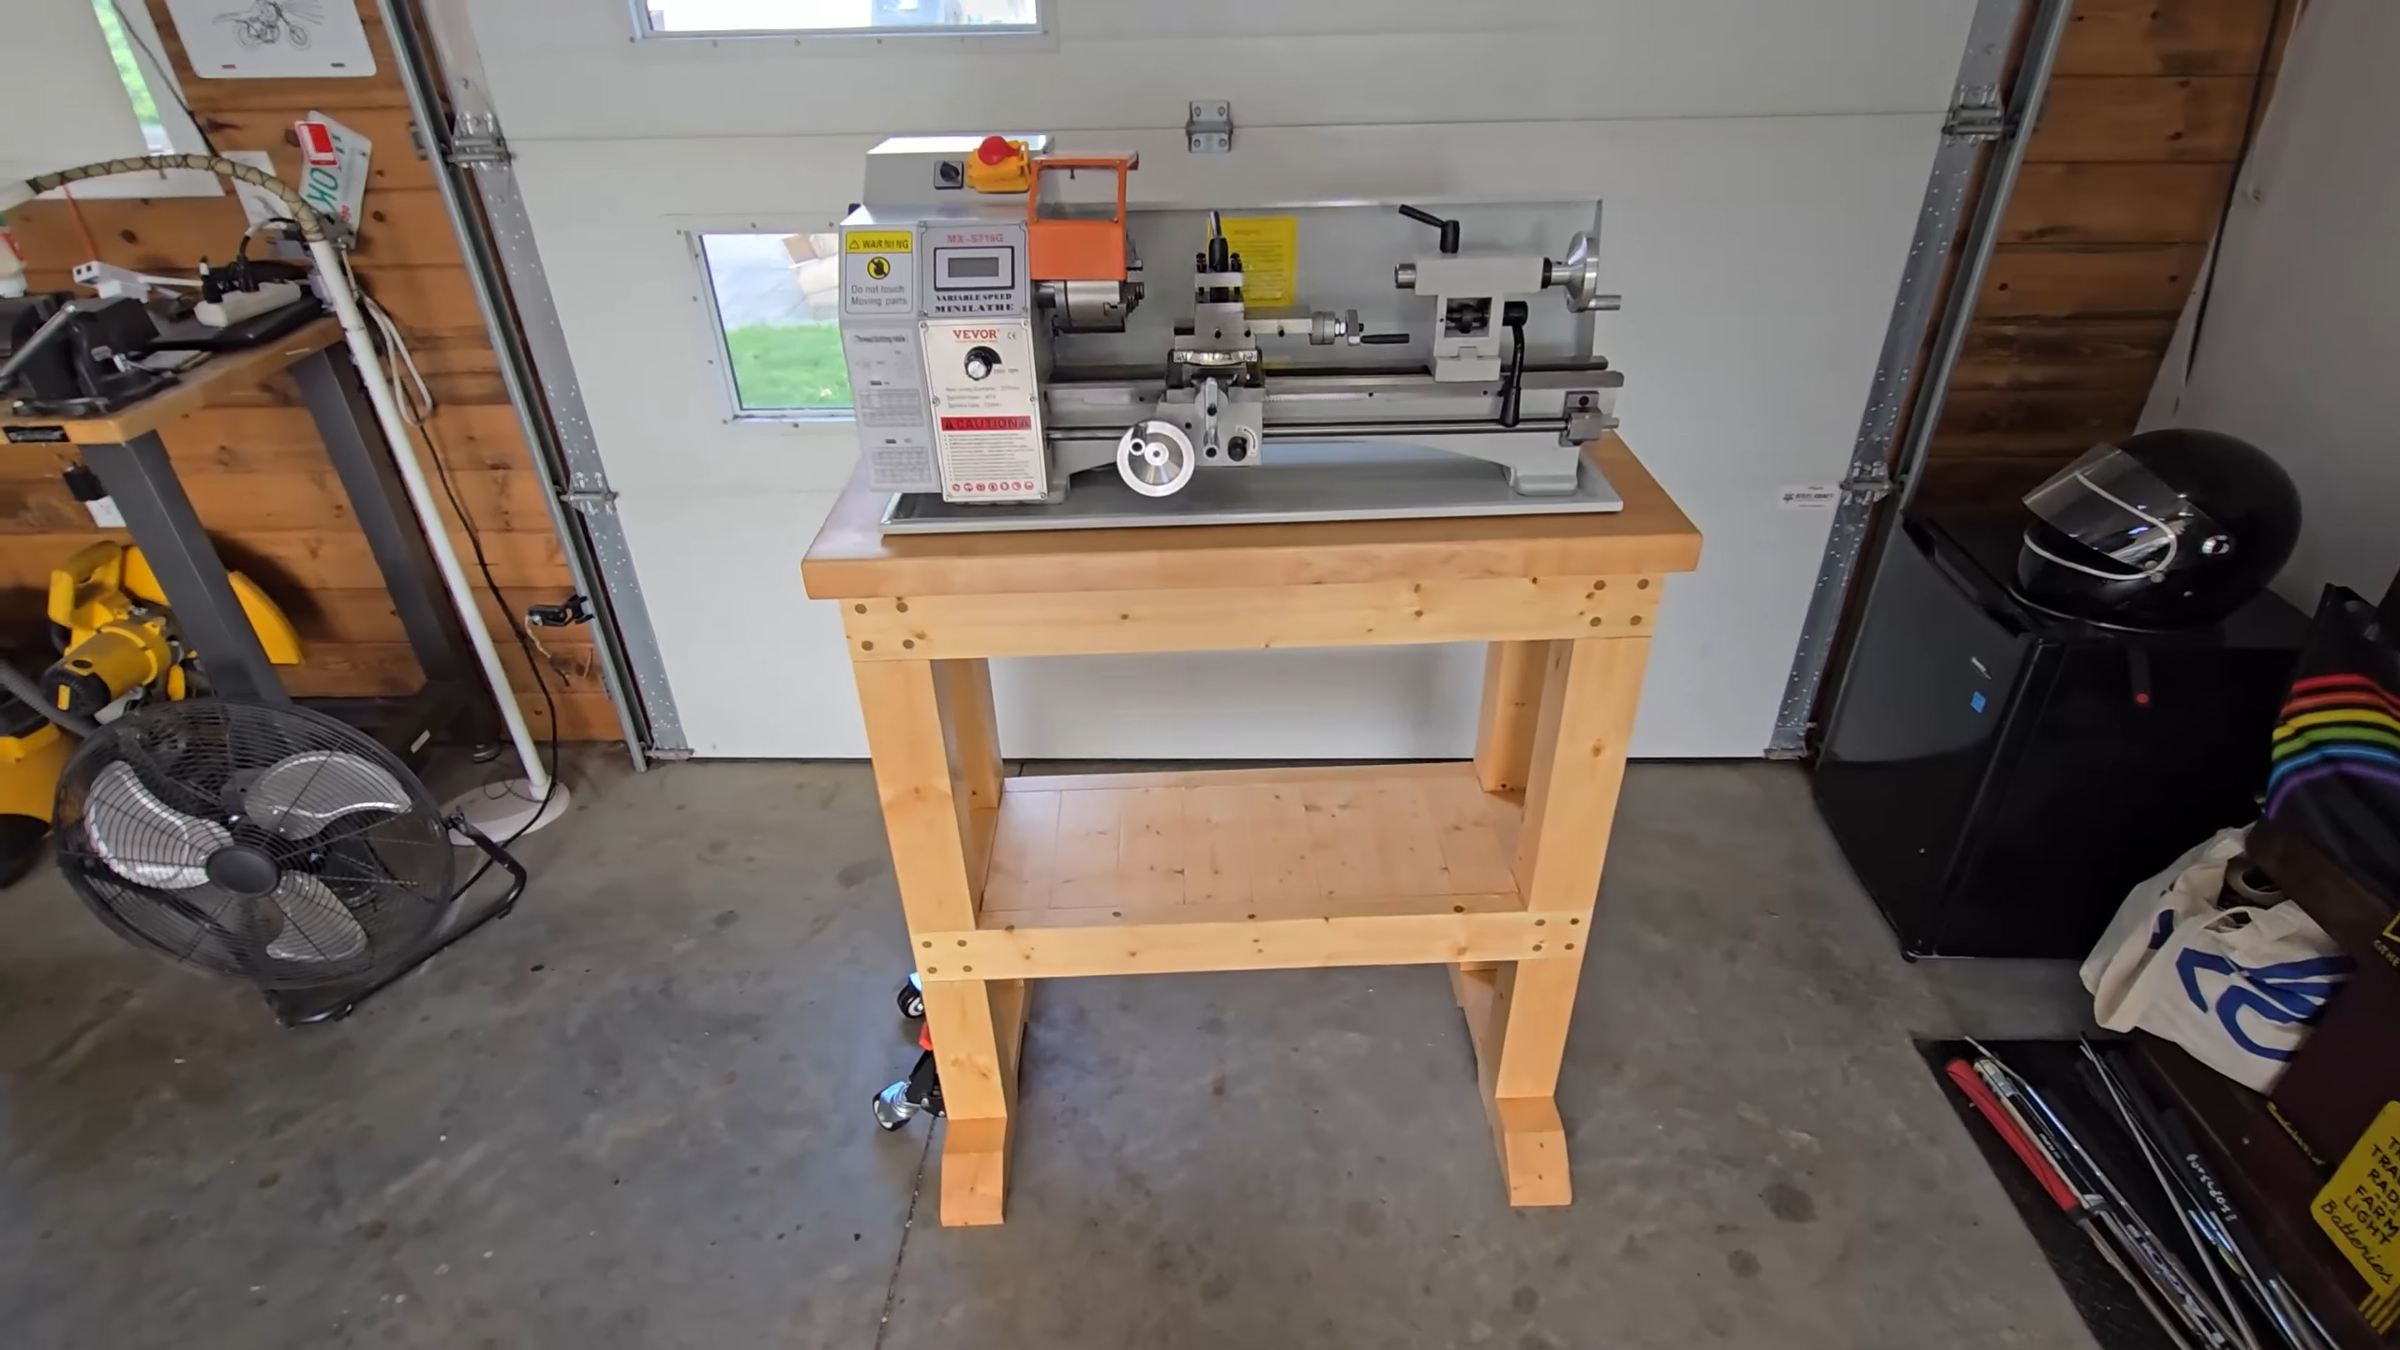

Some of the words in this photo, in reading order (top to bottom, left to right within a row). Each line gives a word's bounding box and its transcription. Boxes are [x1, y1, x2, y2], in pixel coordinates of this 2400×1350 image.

[862, 239, 909, 249] WARNING
[851, 285, 863, 293] Do
[865, 285, 879, 293] not
[880, 285, 905, 293] touch
[851, 295, 882, 307] Moving
[936, 294, 981, 302] VARIABLE
[983, 293, 1012, 301] SPEED
[953, 329, 998, 339] VEVOR
[956, 418, 1017, 429] CAUTION
[2371, 1144, 2400, 1186] TRA
[2355, 1185, 2400, 1238] FARM
[2343, 1195, 2392, 1245] LIGHT
[2320, 1198, 2394, 1286] Batteries
